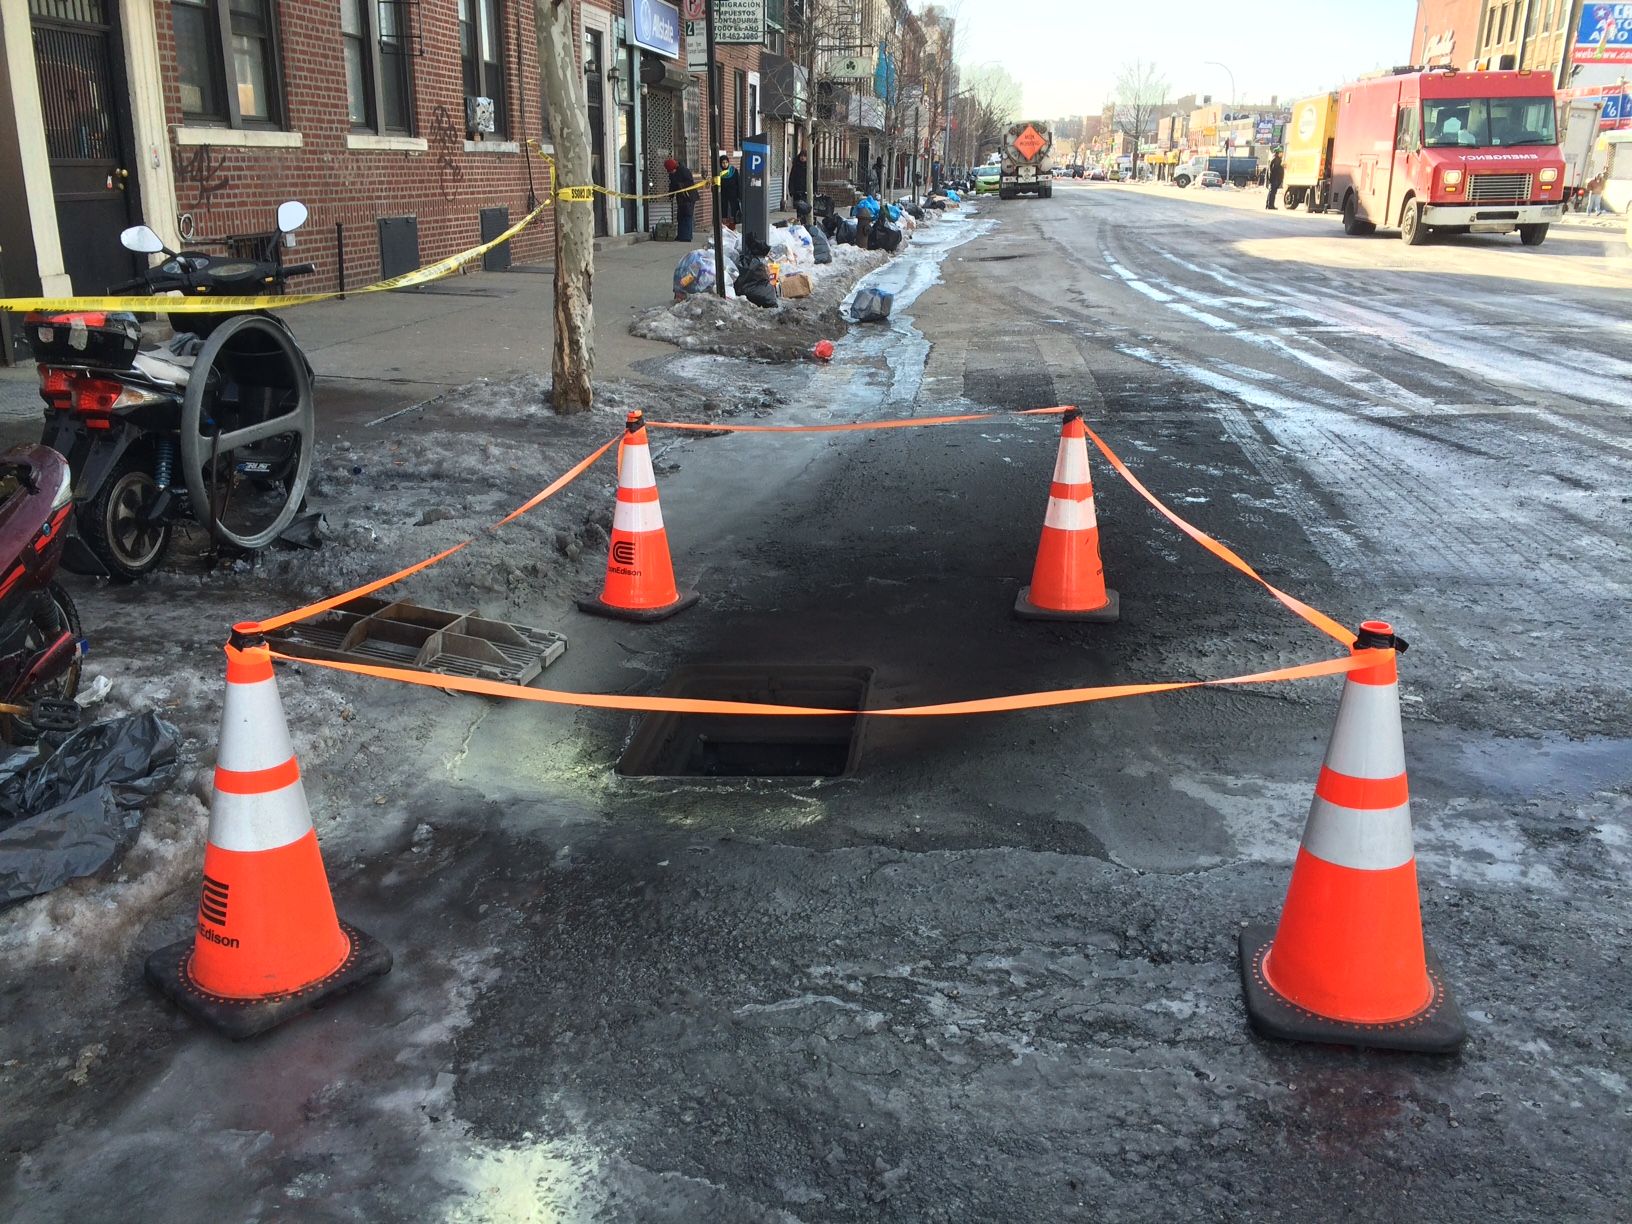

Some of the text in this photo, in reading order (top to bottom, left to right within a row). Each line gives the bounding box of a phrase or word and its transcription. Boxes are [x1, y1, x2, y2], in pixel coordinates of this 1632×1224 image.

[652, 13, 674, 43] Allstate
[1595, 19, 1632, 30] ATO
[751, 155, 762, 170] P
